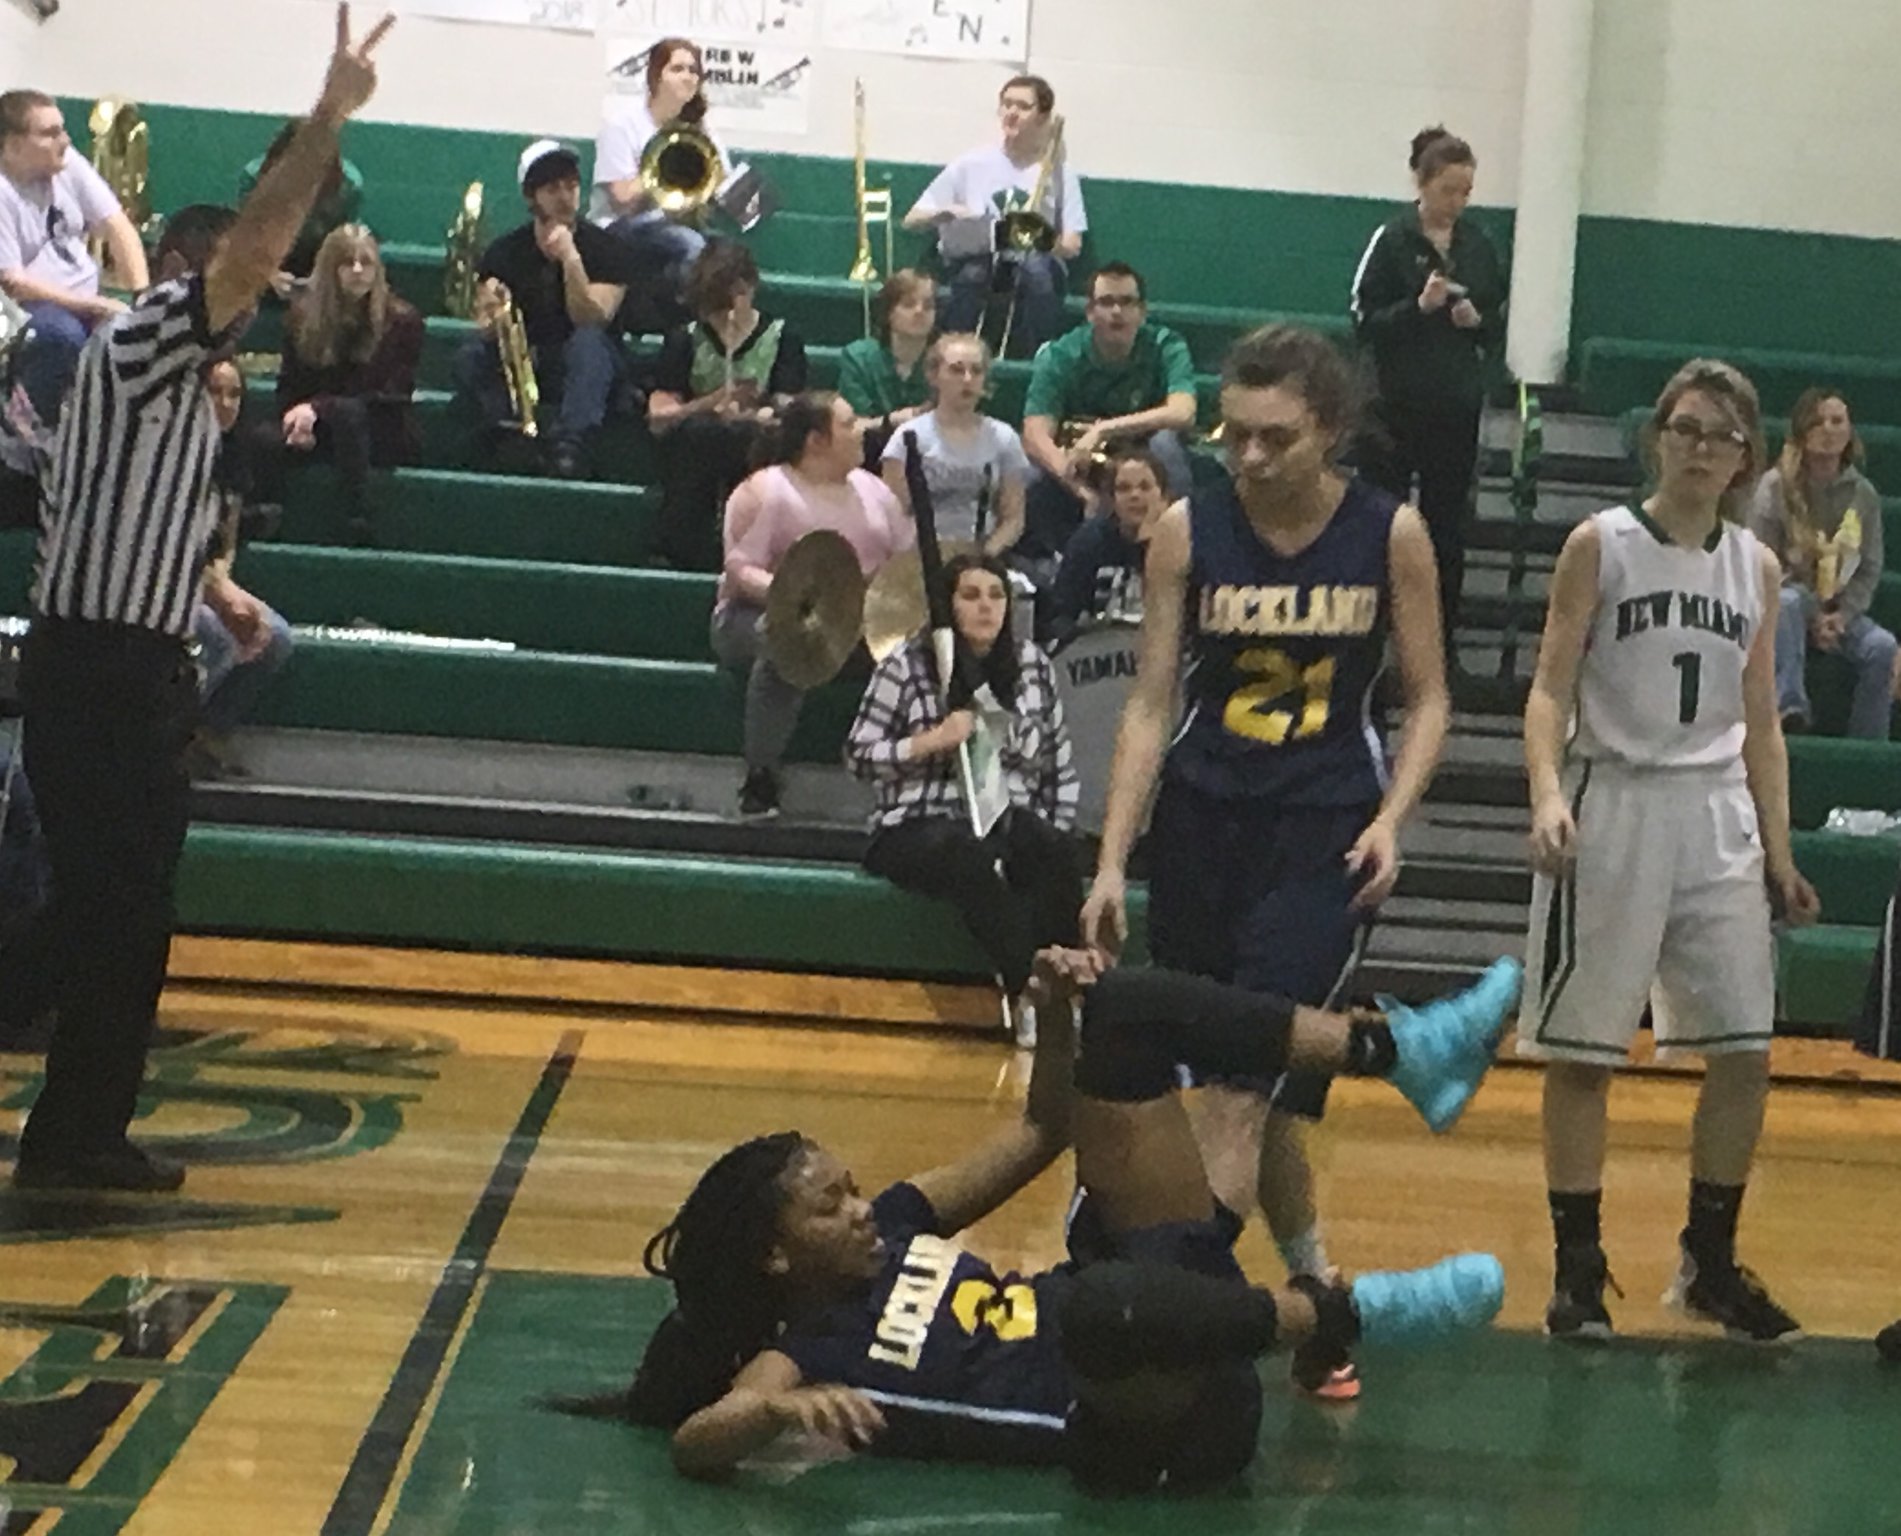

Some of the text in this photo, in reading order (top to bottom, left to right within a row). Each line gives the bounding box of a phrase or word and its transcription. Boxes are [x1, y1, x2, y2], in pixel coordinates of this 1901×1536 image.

[1199, 583, 1379, 637] LOCKLAND
[1615, 588, 1674, 642] NEW
[1066, 649, 1139, 688] YAMA
[1222, 648, 1337, 746] 21
[1672, 651, 1702, 725] 1
[950, 1279, 1038, 1342] 3
